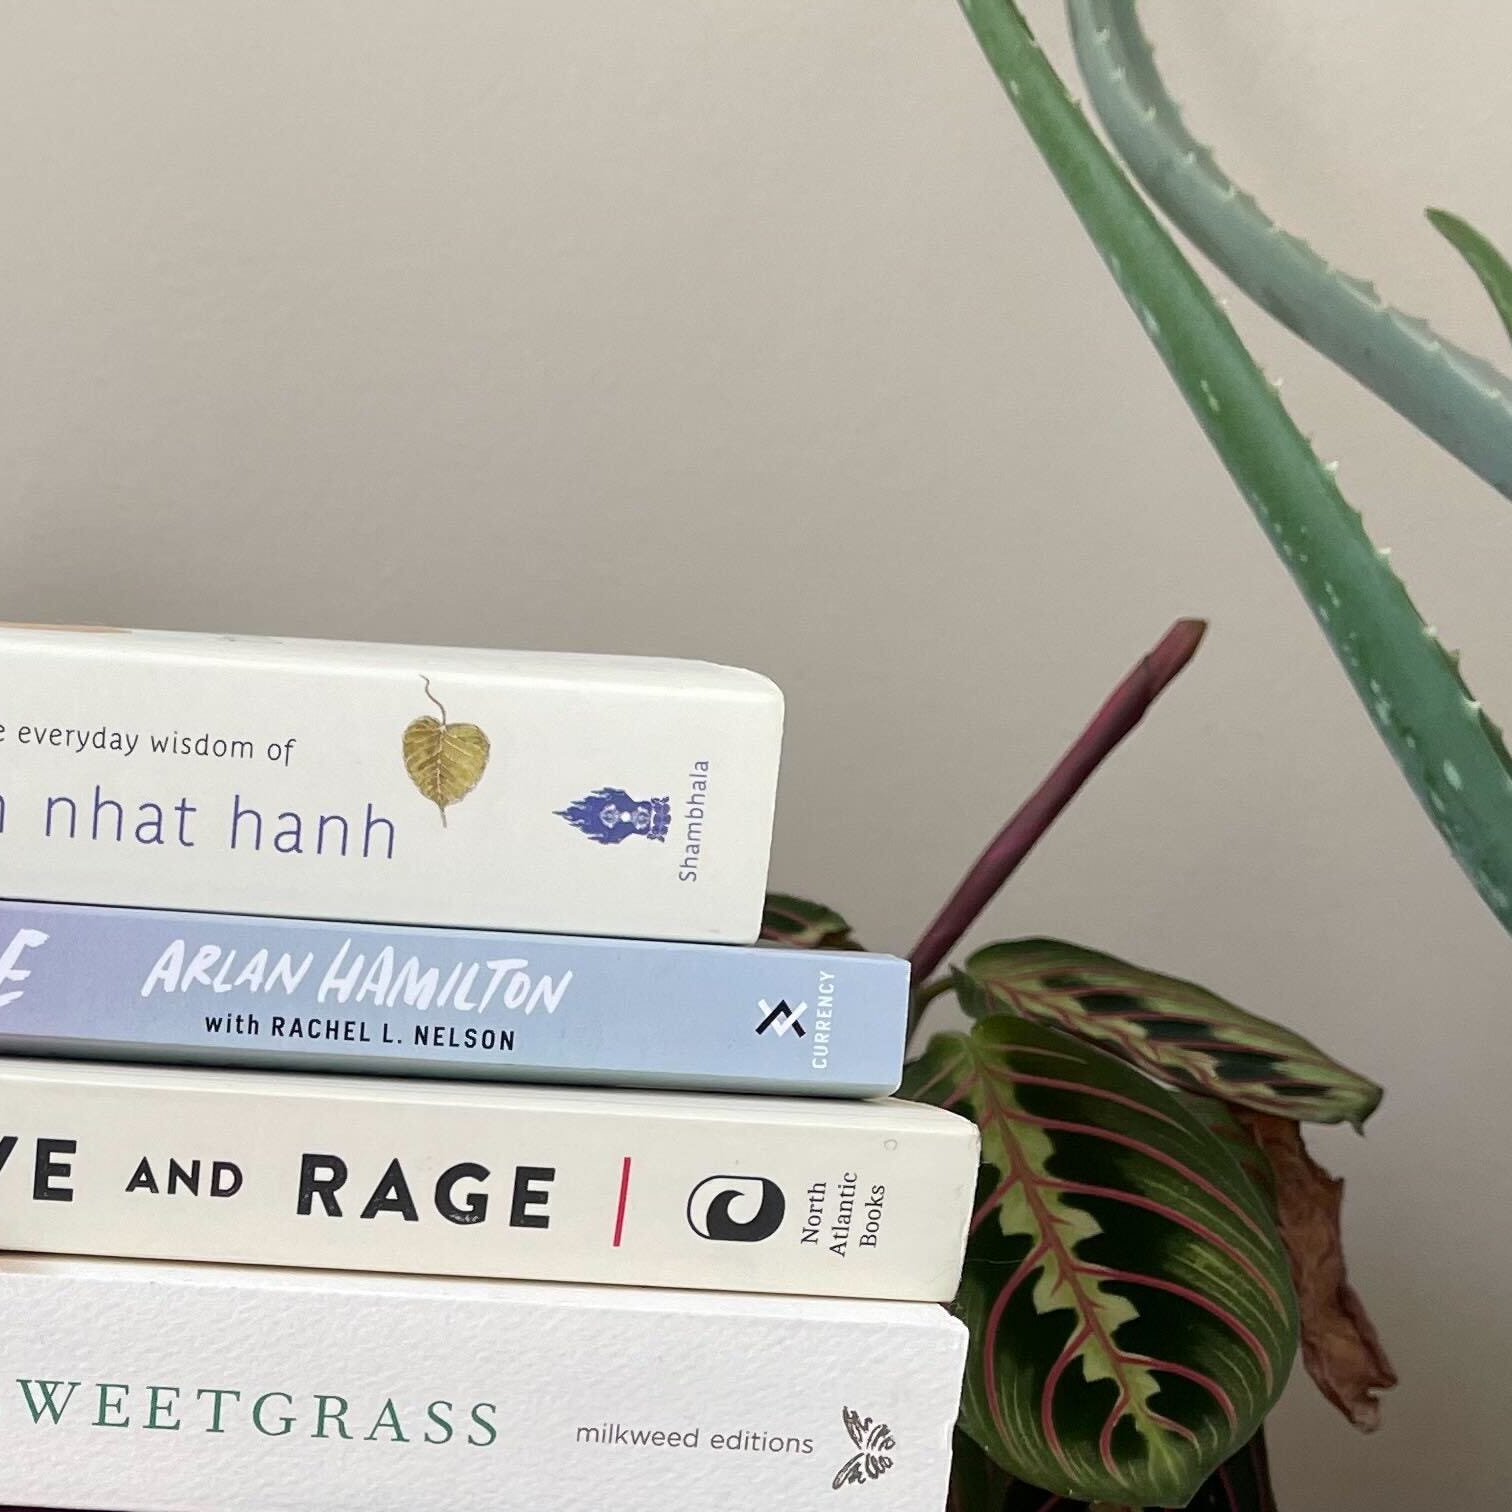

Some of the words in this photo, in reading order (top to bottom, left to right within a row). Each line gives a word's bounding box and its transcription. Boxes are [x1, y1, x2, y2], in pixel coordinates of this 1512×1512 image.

[19, 726, 138, 756] everyday
[151, 734, 253, 758] wisdom
[268, 739, 296, 766] of
[46, 785, 196, 847] nhat
[231, 795, 394, 859] hanh
[679, 761, 709, 882] Shambhala
[141, 940, 313, 997] ARLAN
[318, 938, 573, 1015] HAMILTON
[205, 1013, 258, 1035] with
[272, 1017, 370, 1042] RACHEL
[383, 1023, 401, 1043] L.
[415, 1025, 514, 1050] NELSON
[812, 971, 835, 1068] CURRENCY
[125, 1157, 243, 1197] AND
[297, 1154, 555, 1229] RAGE
[801, 1183, 826, 1244] North
[829, 1173, 857, 1257] Atlantic
[859, 1185, 885, 1248] Books
[577, 1424, 699, 1447] milkweed
[711, 1430, 813, 1454] editions
